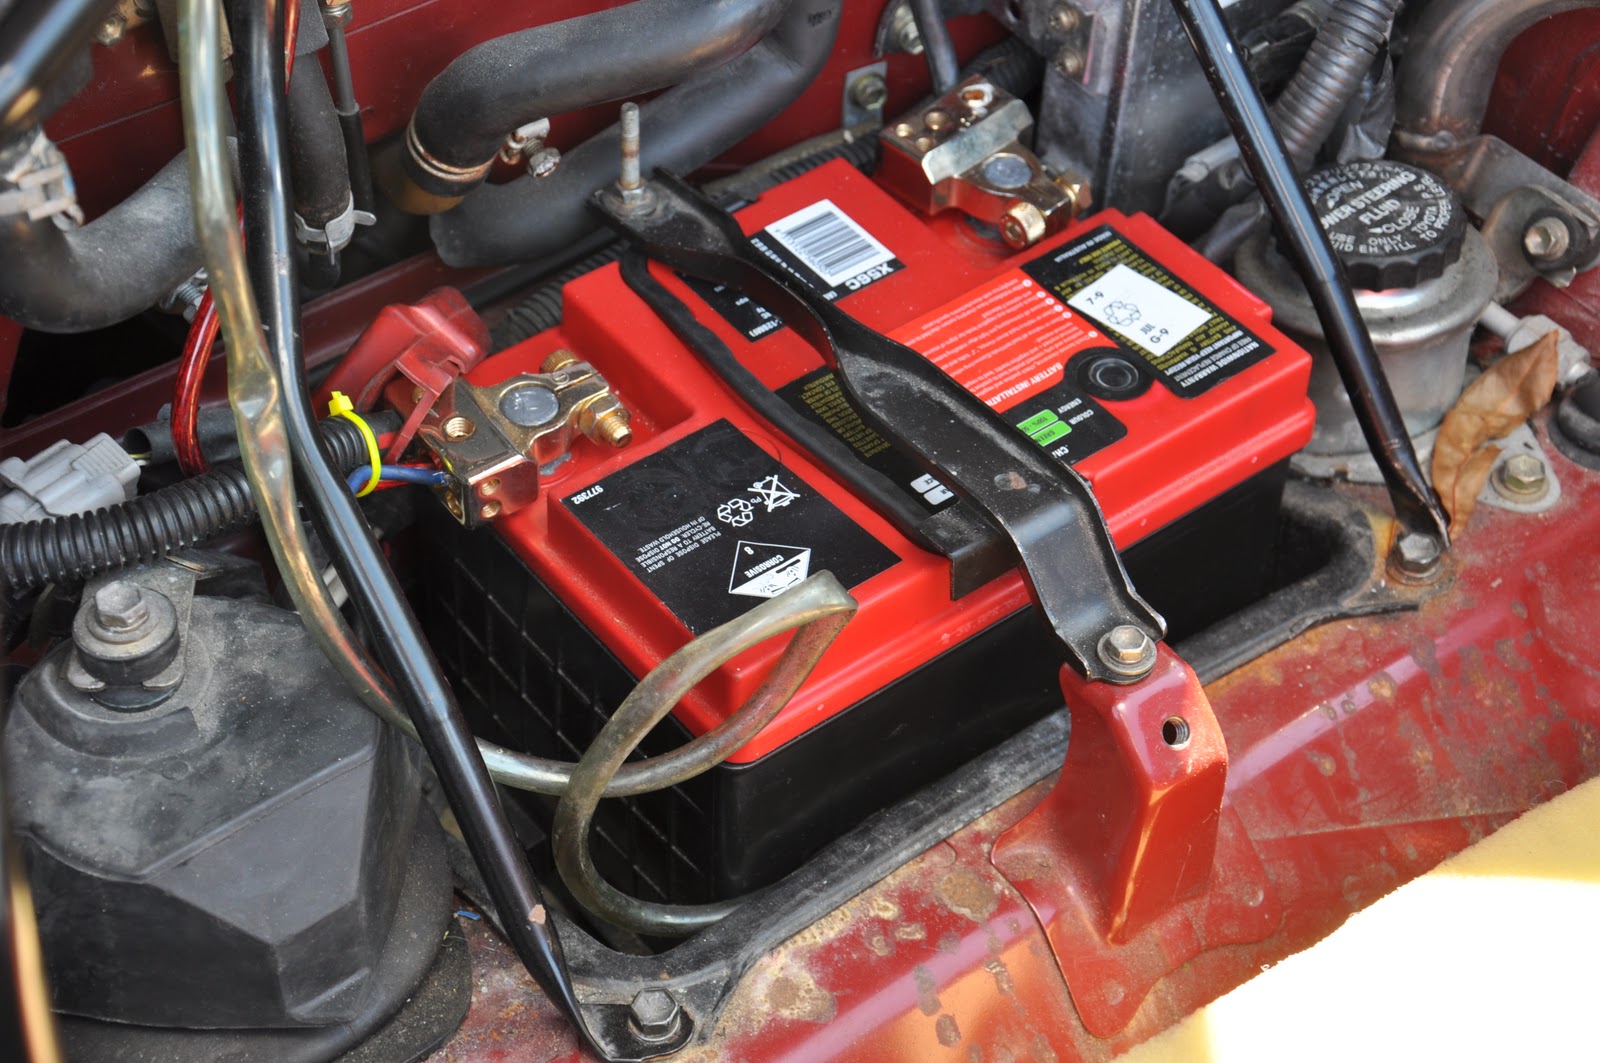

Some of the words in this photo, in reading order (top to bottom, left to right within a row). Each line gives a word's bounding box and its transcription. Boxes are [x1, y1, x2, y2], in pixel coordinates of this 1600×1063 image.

[1327, 181, 1364, 201] OPEN
[1350, 171, 1416, 209] STEERING
[1359, 199, 1401, 225] FLUID
[1381, 205, 1420, 233] CLOSE
[1329, 231, 1356, 244] USE
[1368, 234, 1401, 246] ONLY
[1411, 206, 1438, 234] TOYOTA
[1383, 241, 1416, 253] FILL
[1419, 230, 1438, 241] TO
[845, 261, 893, 289] X56C
[1139, 323, 1155, 335] JUL
[1149, 327, 1169, 343] G-9
[1215, 341, 1259, 367] NATIONWIDE
[1029, 362, 1063, 384] BATTERY
[1180, 363, 1218, 387] WARRANTY
[1057, 397, 1082, 413] ENERGY
[1068, 408, 1094, 424] COLOUR
[570, 484, 603, 504] 977392
[749, 495, 762, 504] Pb
[658, 523, 693, 542] HOUSEHOLD
[670, 536, 680, 544] DO
[691, 525, 716, 541] BATTERY
[699, 530, 721, 544] PLEASE
[658, 540, 672, 550] NOT
[672, 541, 700, 557] DISPOSE
[743, 545, 754, 555] 8
[634, 546, 660, 562] DISPOSE
[637, 545, 681, 567] RESPONSIBLE
[666, 554, 675, 562] OF
[646, 559, 665, 573] SPENT
[744, 554, 790, 578] CORROSIVE
